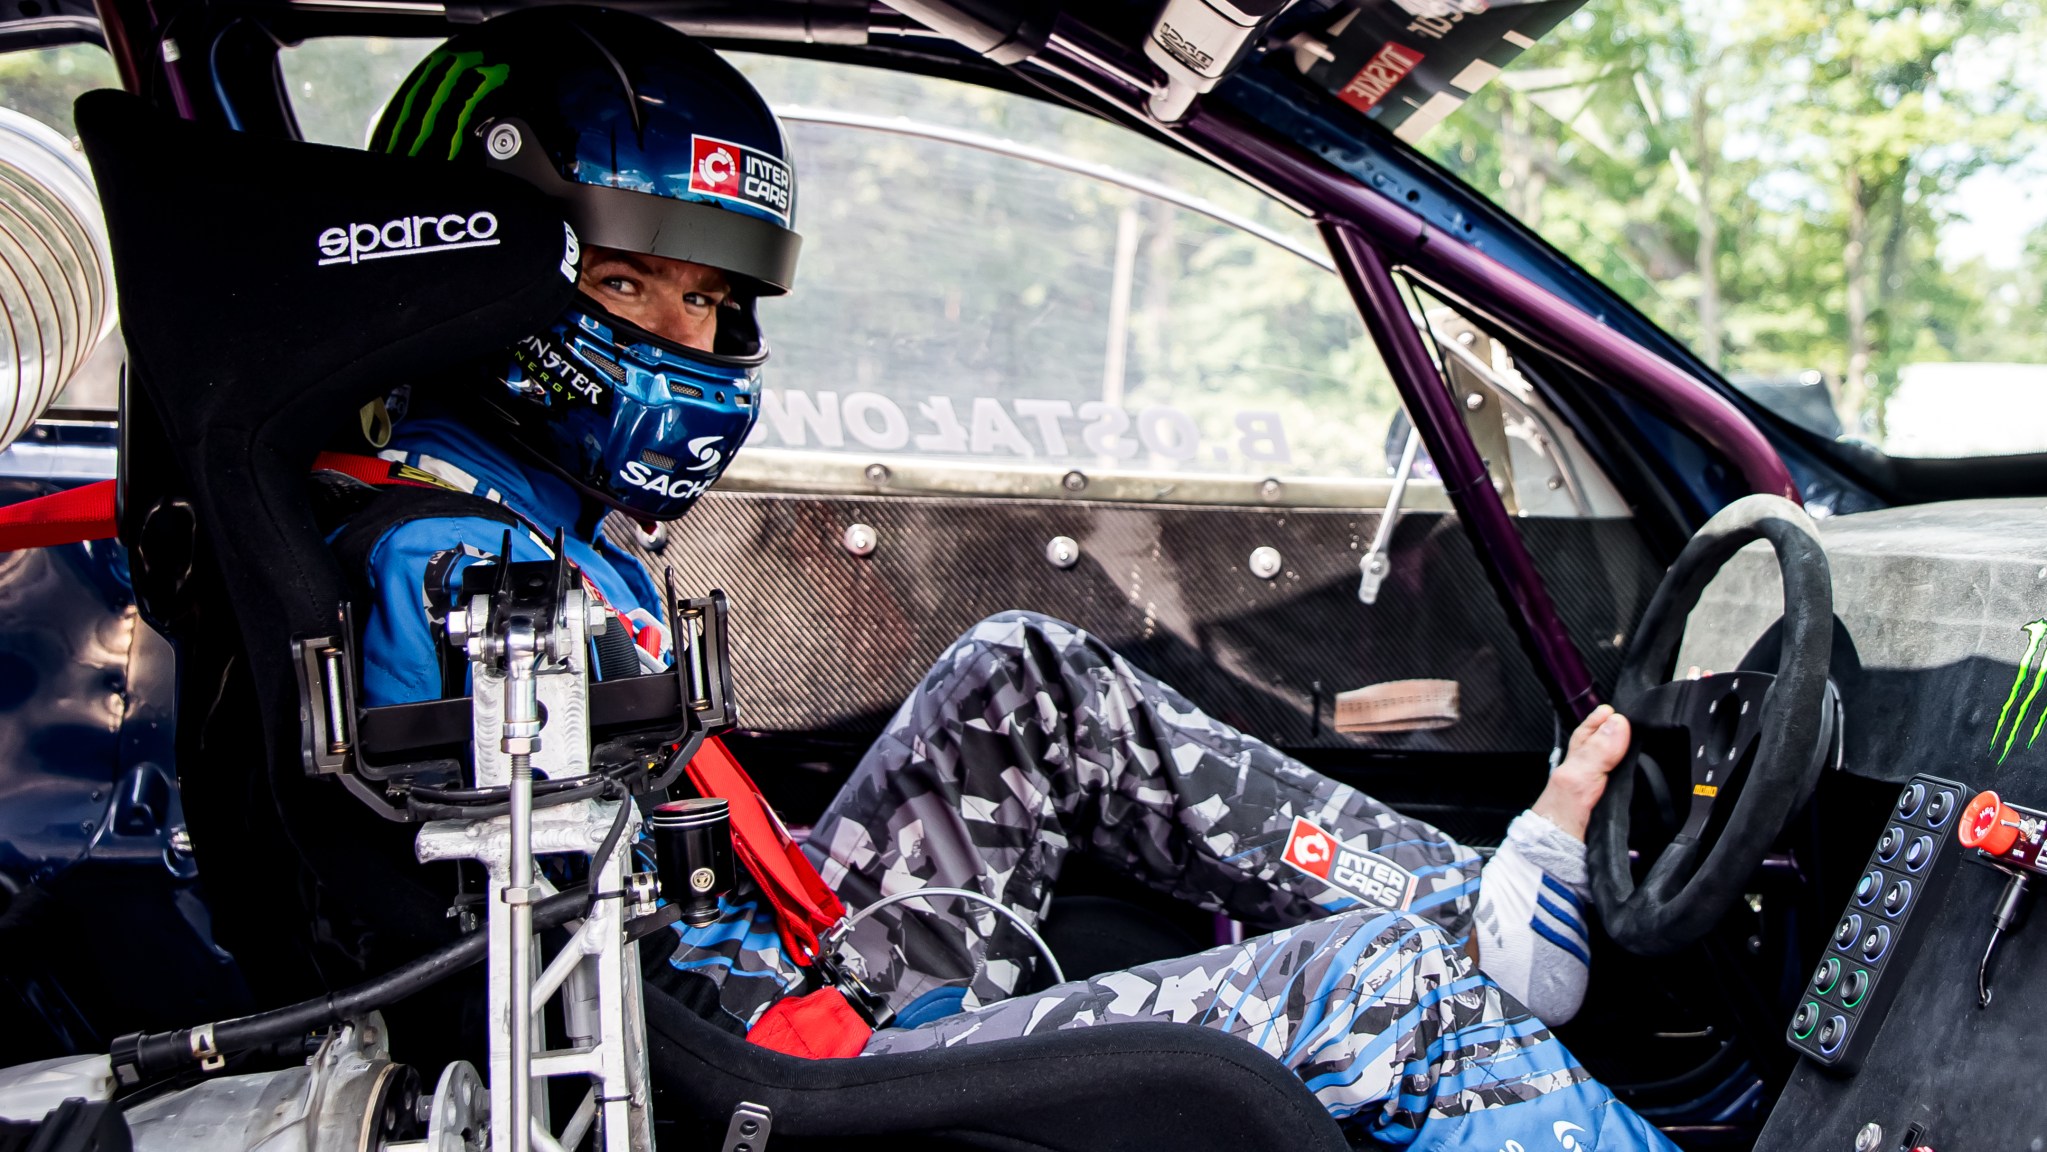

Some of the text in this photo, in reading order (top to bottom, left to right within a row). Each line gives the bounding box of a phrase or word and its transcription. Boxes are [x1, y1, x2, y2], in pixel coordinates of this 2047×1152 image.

[745, 176, 788, 209] CARS
[746, 155, 789, 190] INTER
[318, 211, 498, 265] sparco
[514, 350, 576, 401] NERGY
[517, 335, 603, 405] NSTER
[619, 461, 717, 499] SACH
[1333, 866, 1401, 907] CARS
[1337, 850, 1405, 891] INTER
